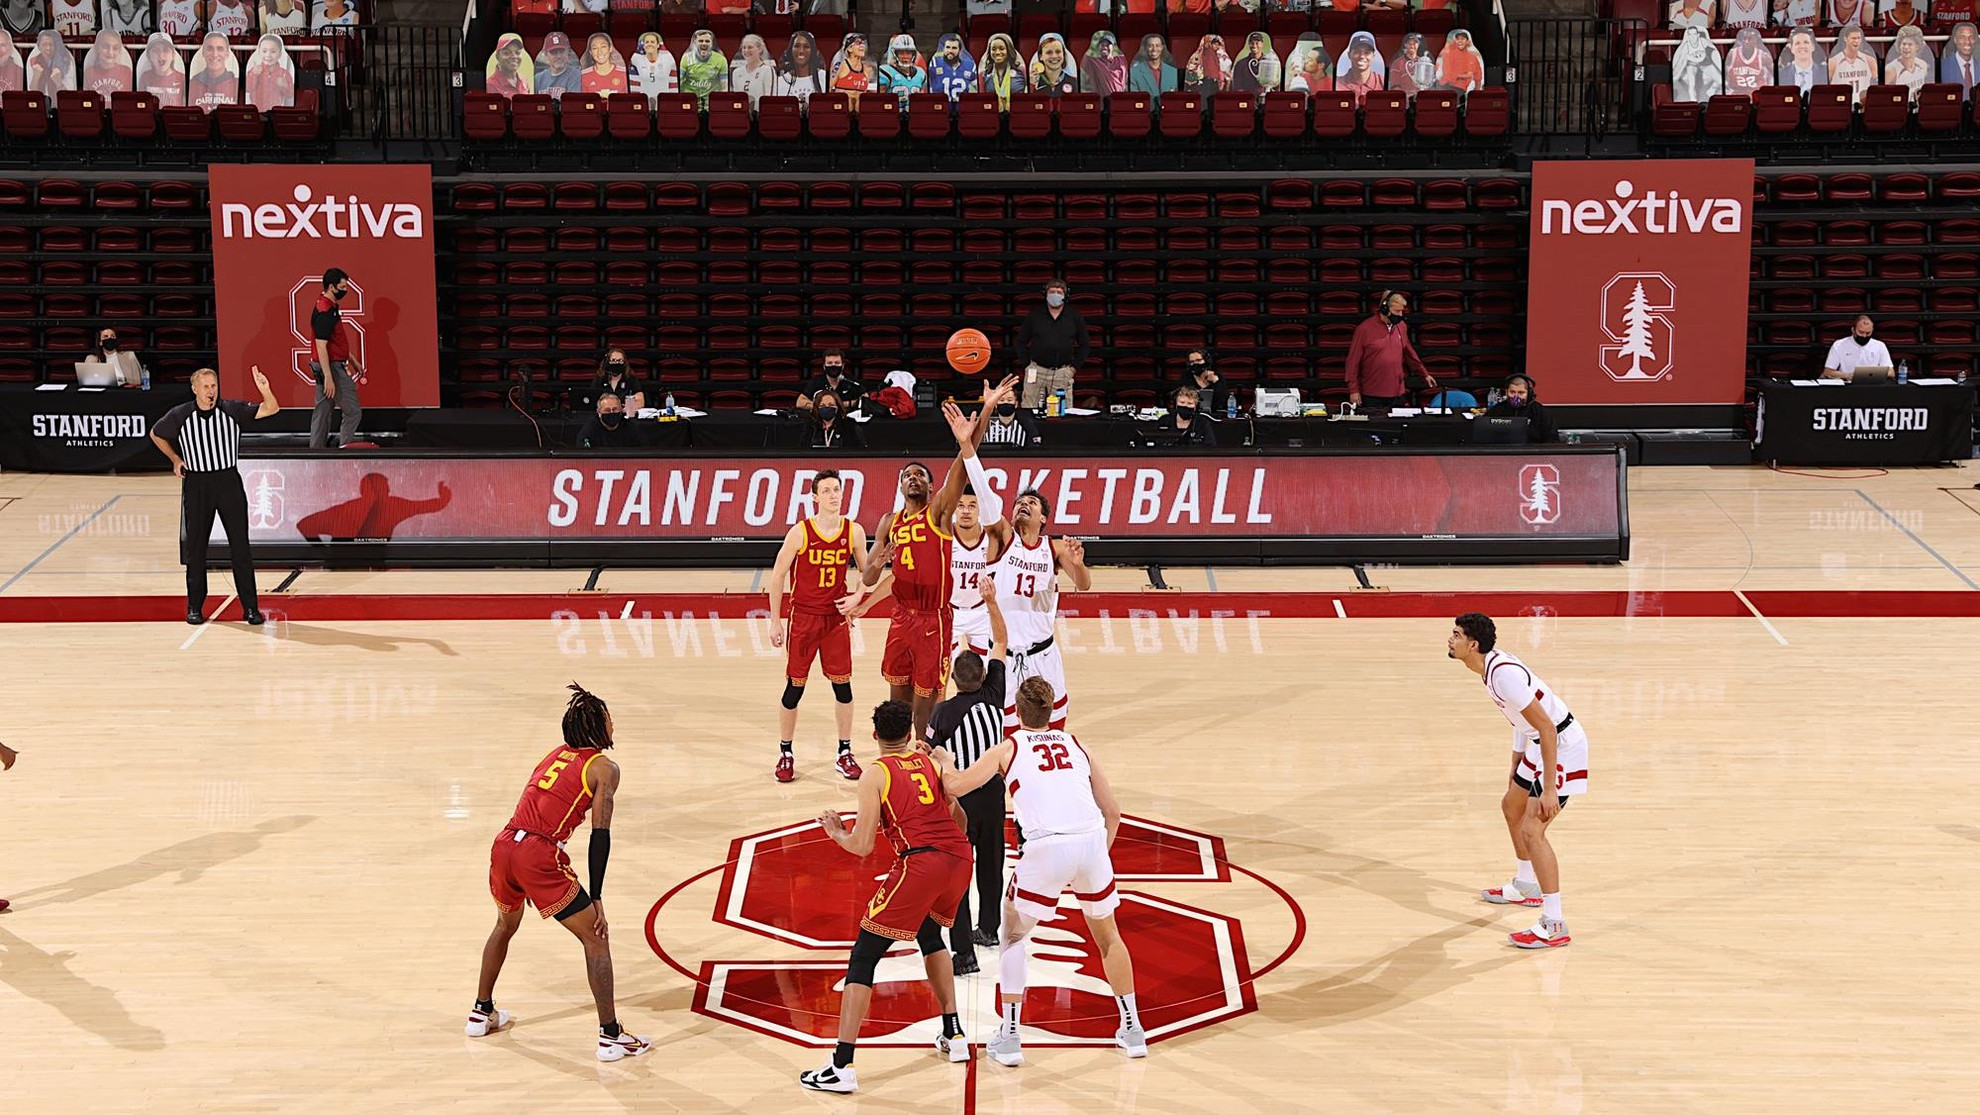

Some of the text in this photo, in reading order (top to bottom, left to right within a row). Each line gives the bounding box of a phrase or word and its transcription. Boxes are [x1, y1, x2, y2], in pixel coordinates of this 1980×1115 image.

[56, 12, 92, 23] STANFORD
[162, 20, 177, 35] 30
[67, 22, 80, 36] 11
[326, 74, 332, 84] 4
[1636, 70, 1644, 80] 2
[942, 77, 967, 102] 12
[222, 184, 423, 238] nextiva
[1541, 180, 1742, 234] nextiva
[33, 414, 146, 438] STANFORD
[1813, 408, 1928, 431] STANFORD
[548, 467, 1273, 526] STANFORD SKETBALL
[809, 549, 847, 565] USC
[901, 546, 915, 570] 4
[951, 560, 986, 570] STANFOR
[1008, 555, 1049, 573] STANFORD
[819, 567, 836, 588] 13
[960, 572, 979, 590] 14
[1014, 572, 1036, 598] 13
[1026, 734, 1065, 743] KISUNAS
[1032, 743, 1074, 772] 32
[538, 760, 569, 790] 5
[910, 772, 935, 805] 3
